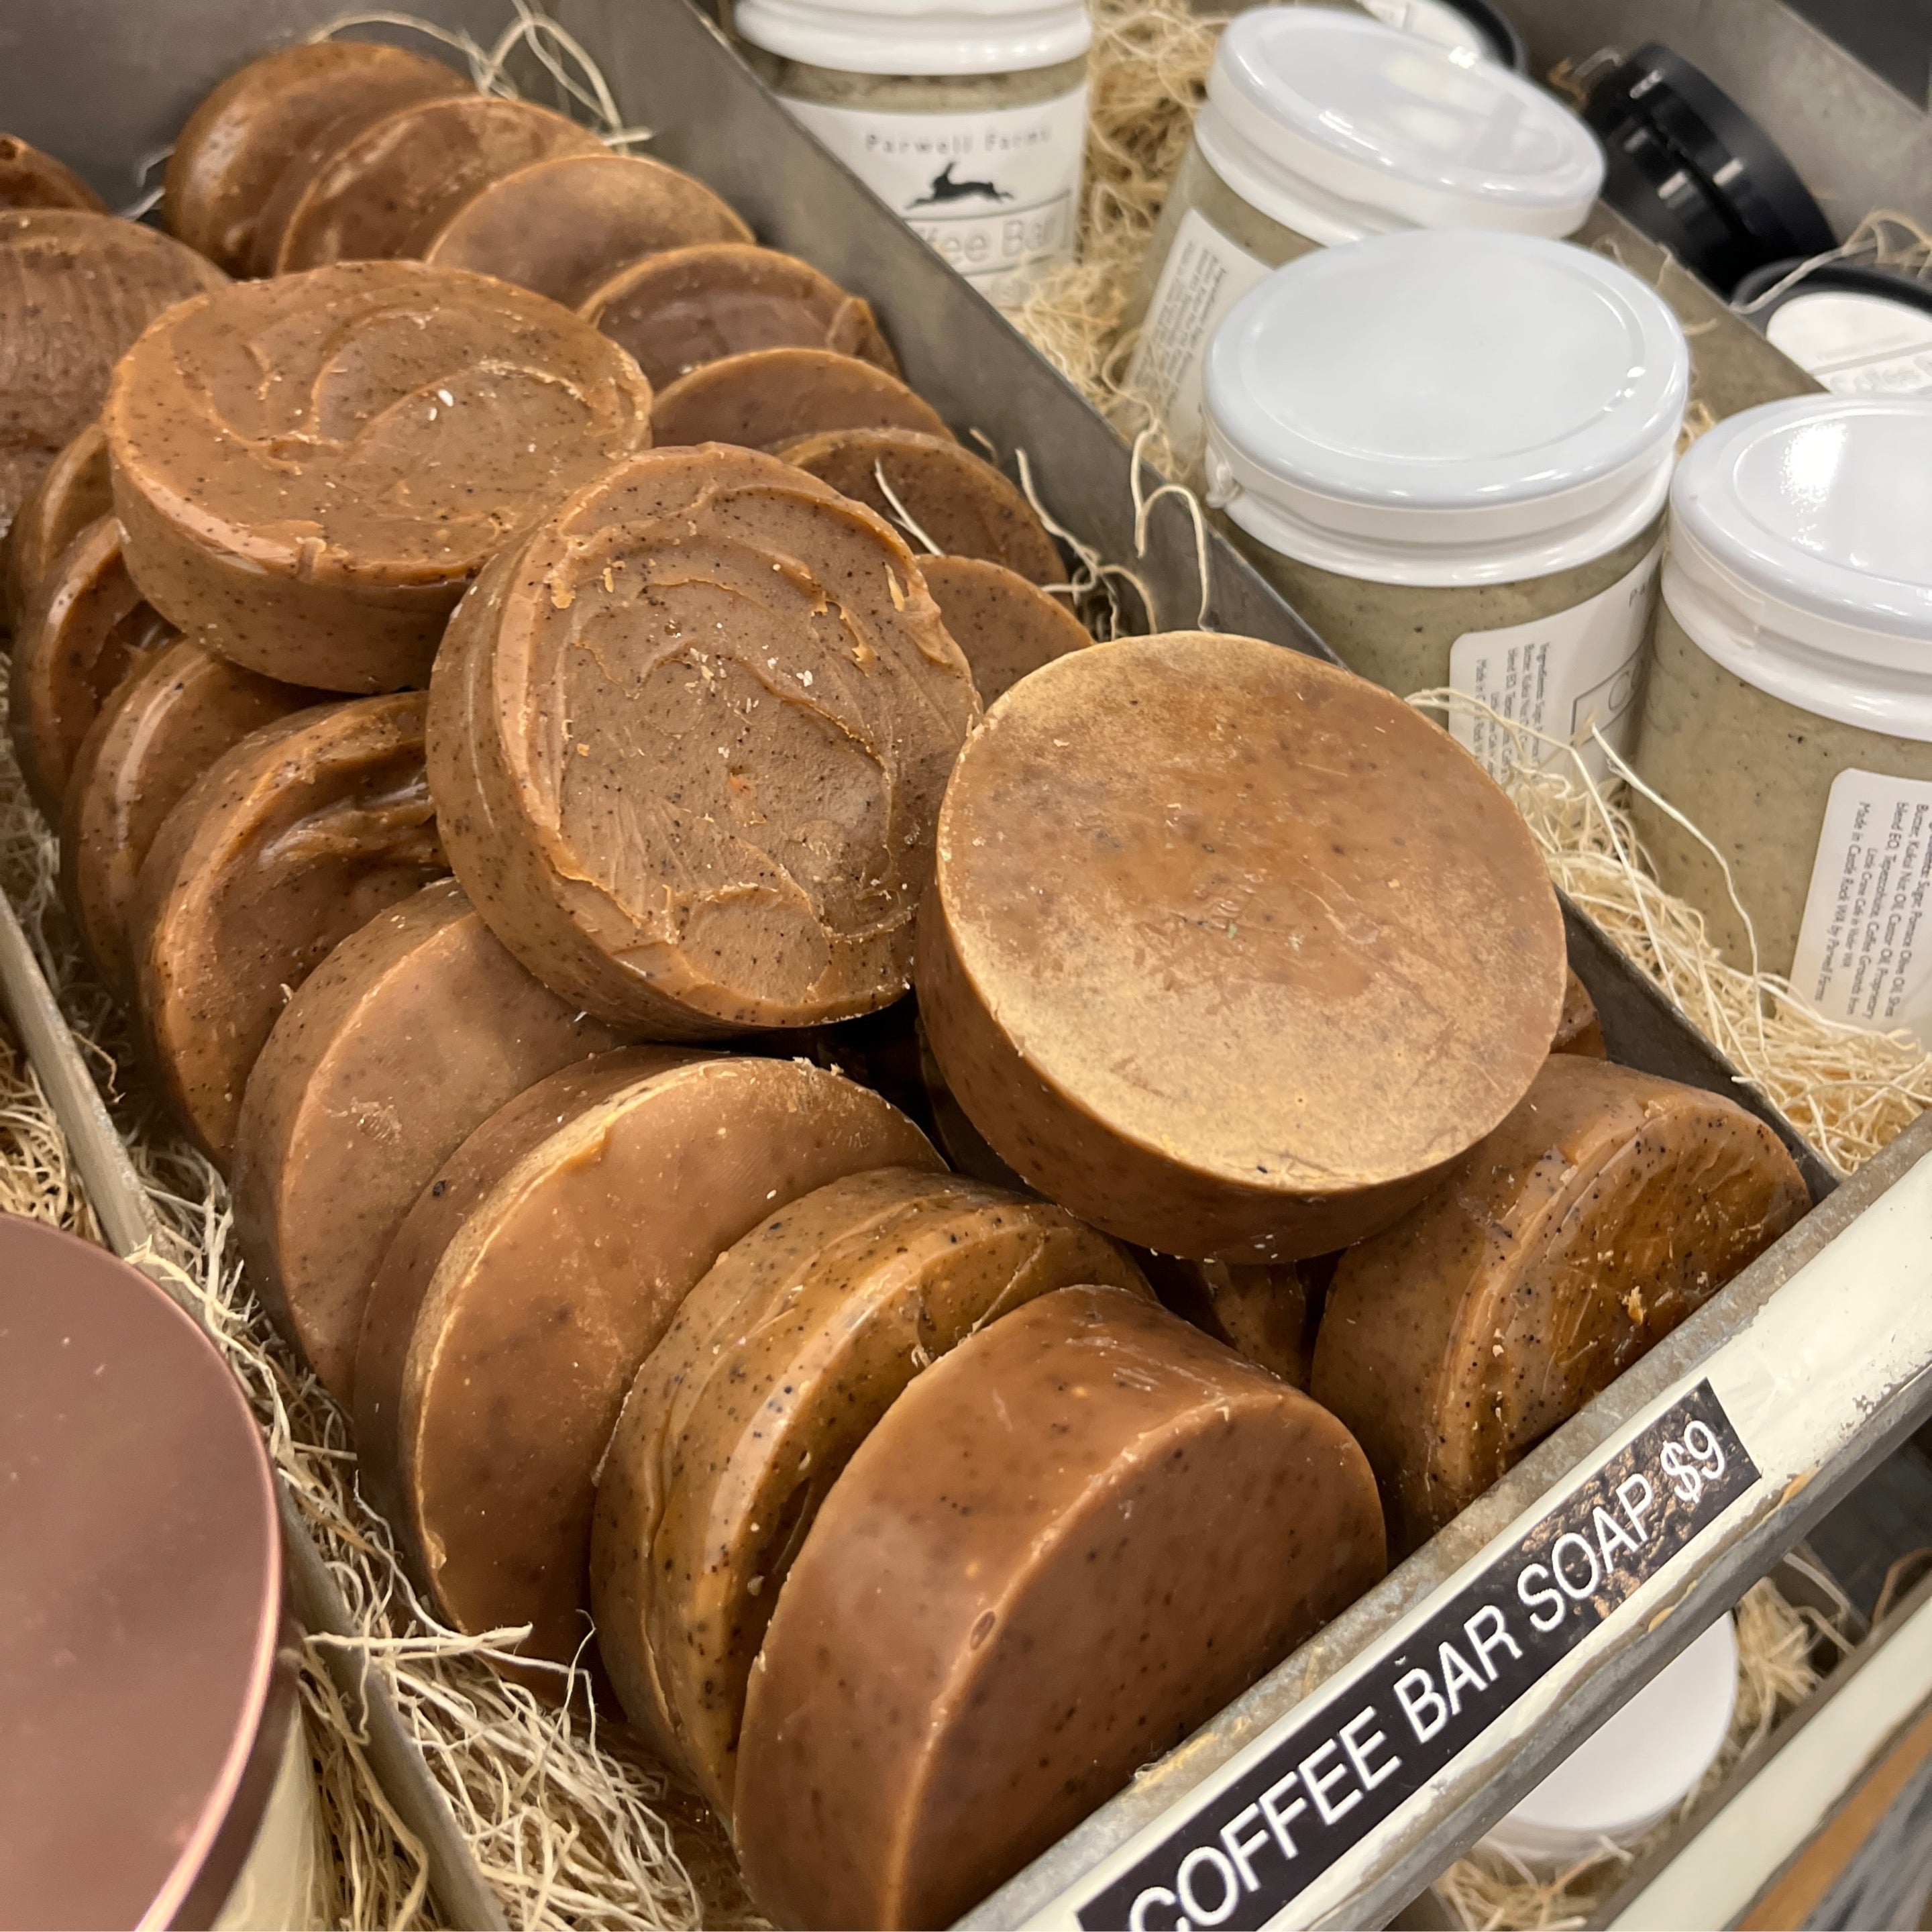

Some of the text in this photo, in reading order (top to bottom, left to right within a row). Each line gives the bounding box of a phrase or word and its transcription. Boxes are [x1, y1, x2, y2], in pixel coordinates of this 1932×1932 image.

[1129, 1418, 1727, 1932] COFFEE BAR SOAP $9
